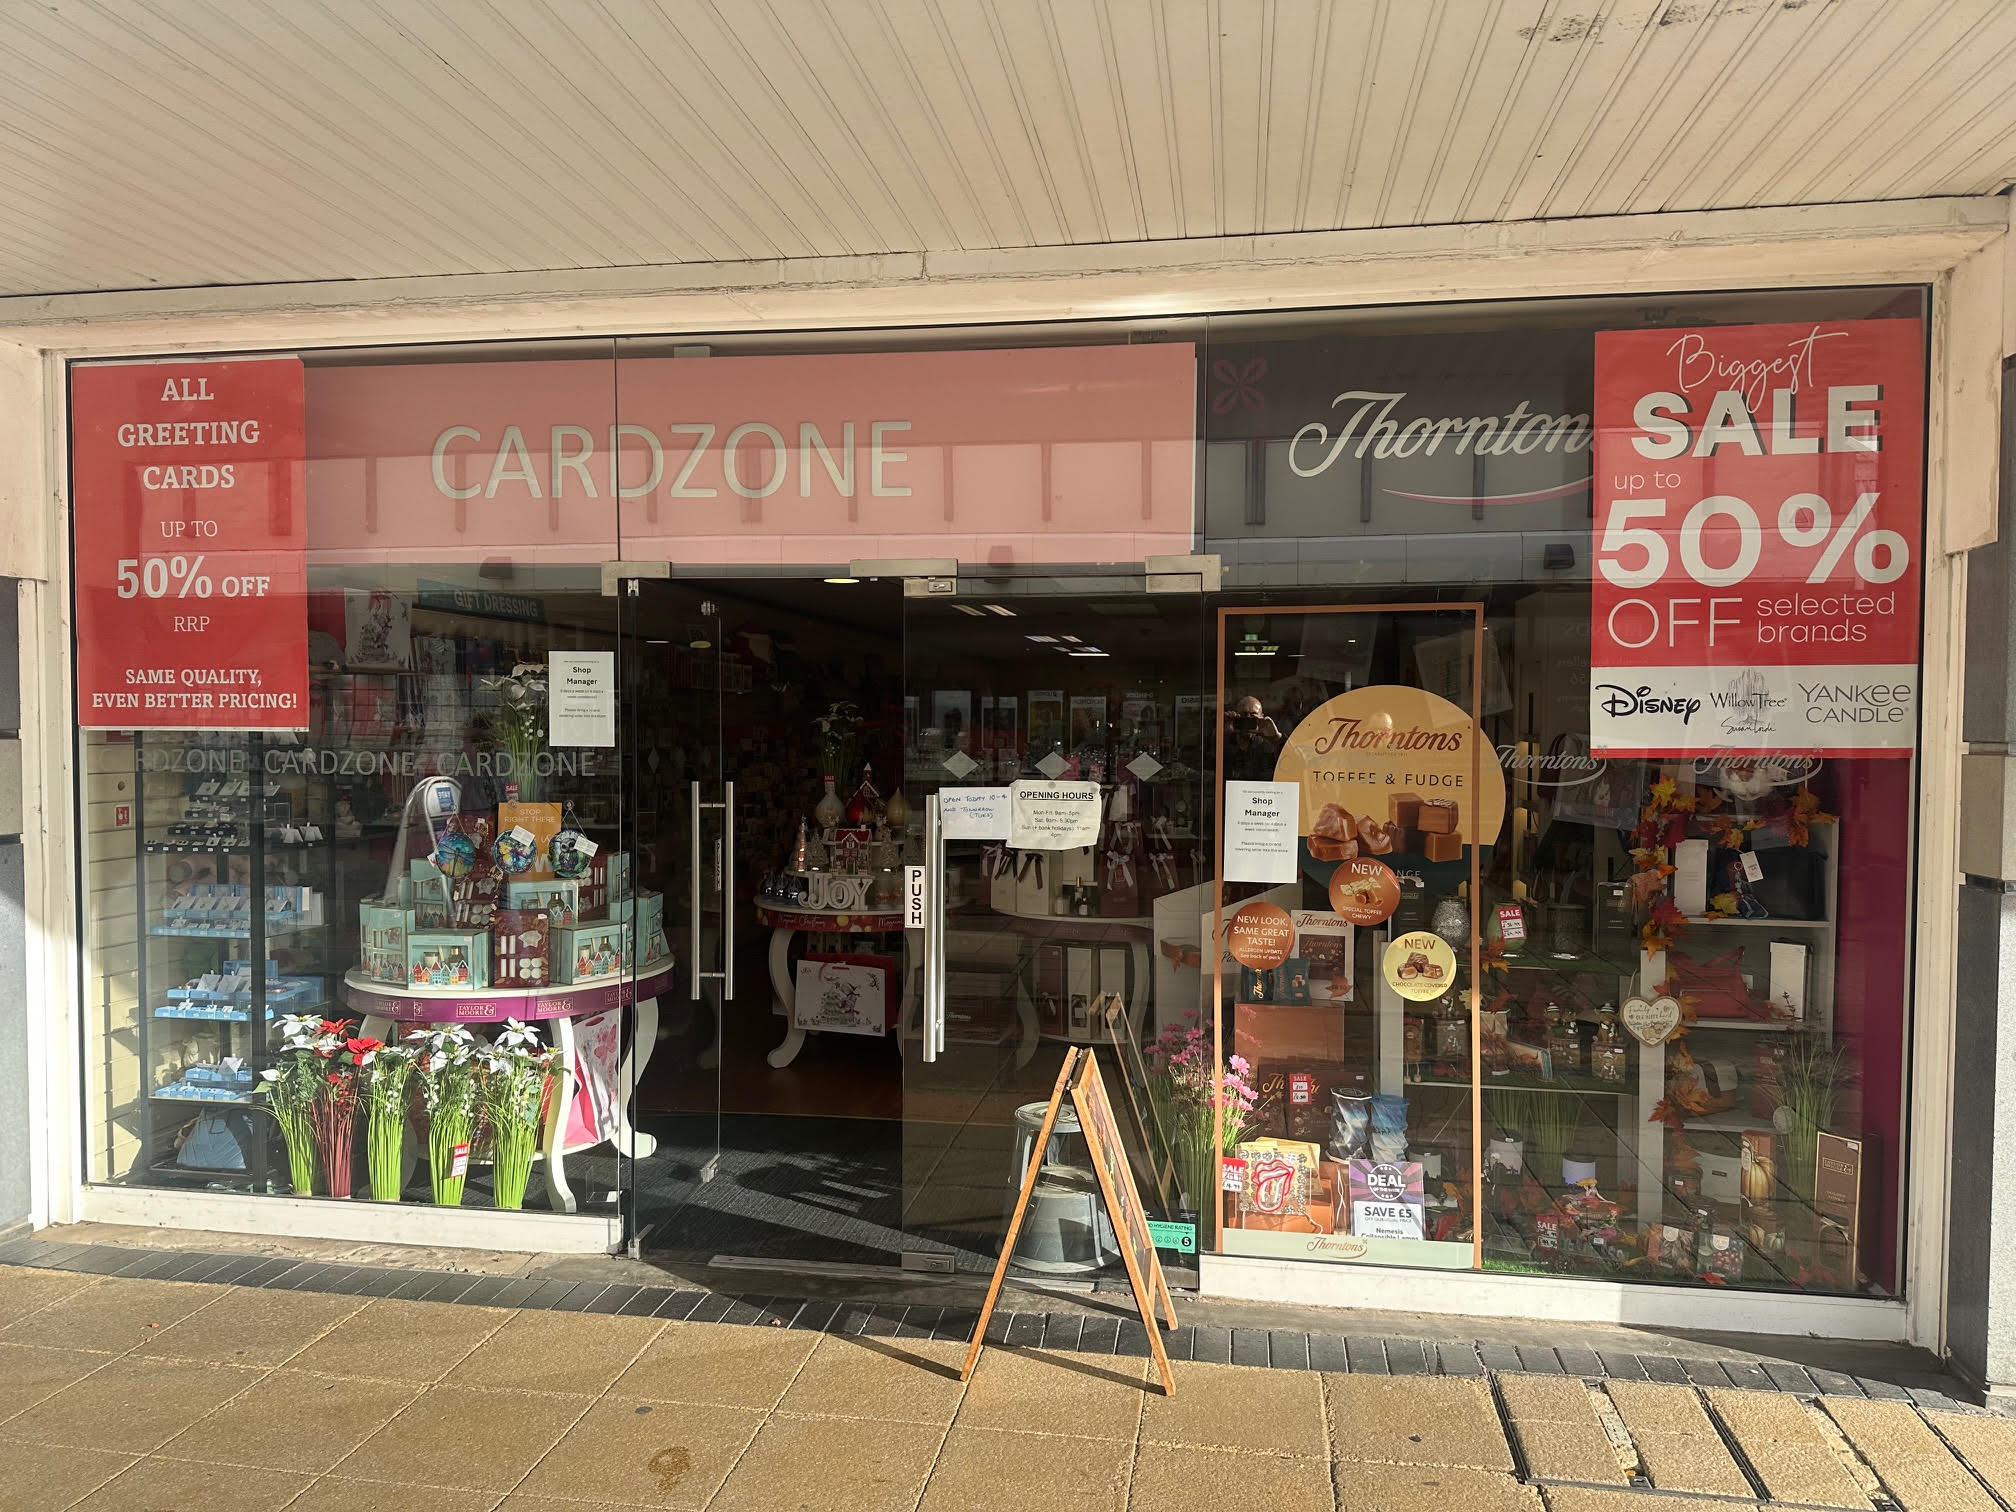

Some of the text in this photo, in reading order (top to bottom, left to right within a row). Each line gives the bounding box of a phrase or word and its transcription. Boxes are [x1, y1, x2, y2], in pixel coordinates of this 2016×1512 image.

[1667, 325, 1849, 414] Biggest
[161, 378, 214, 401] ALL
[1631, 384, 1884, 460] SALE
[117, 420, 260, 447] GREETING
[430, 420, 912, 499] CARDZONE
[143, 465, 236, 490] CARDS
[1614, 470, 1681, 495] up to
[160, 520, 218, 538] UP TO
[1598, 492, 1910, 589] 50%
[117, 555, 271, 599] 50% OFF
[454, 589, 538, 617] GIFT DRESSING
[174, 616, 211, 632] RRP
[1607, 591, 1895, 648] OFF selected
[1757, 619, 1867, 643] brands
[126, 669, 262, 687] SAME QUALITY,
[573, 666, 592, 675] Shop
[566, 678, 598, 686] Manager
[92, 693, 297, 709] EVEN BETTER PRICING!
[1314, 717, 1463, 755] Thorntons
[264, 749, 415, 777] CARDZONE
[436, 750, 596, 778] CARDZONE
[1495, 744, 1601, 773] Thorntons
[1692, 744, 1815, 774] Thorntons
[1385, 773, 1396, 785] &
[1405, 773, 1463, 787] FUDGE
[505, 784, 518, 792] SALE
[1019, 791, 1094, 800] OPENING HOURS
[1252, 797, 1273, 805] Shop
[519, 808, 542, 816] STOP
[1244, 809, 1280, 818] Manager
[504, 816, 530, 824] RIGHT
[1351, 862, 1383, 876] NEW
[911, 869, 922, 924] PUSH
[1237, 915, 1288, 927] NEW LOOK,
[1296, 913, 1348, 928] Thorntons
[1500, 909, 1521, 918] SALE
[1233, 925, 1290, 937] SAME GREAT
[1247, 937, 1276, 946] TASTE!
[1404, 938, 1436, 949] NEW
[484, 1004, 495, 1015] &
[1222, 1163, 1244, 1173] SALE
[1367, 1173, 1406, 1188] DEAL
[1364, 1206, 1412, 1218] SAVE £5
[1376, 1227, 1404, 1235] Nemesis
[1537, 1221, 1557, 1231] SALE
[1183, 1237, 1189, 1246] 5
[1307, 1236, 1364, 1252] Thorntons
